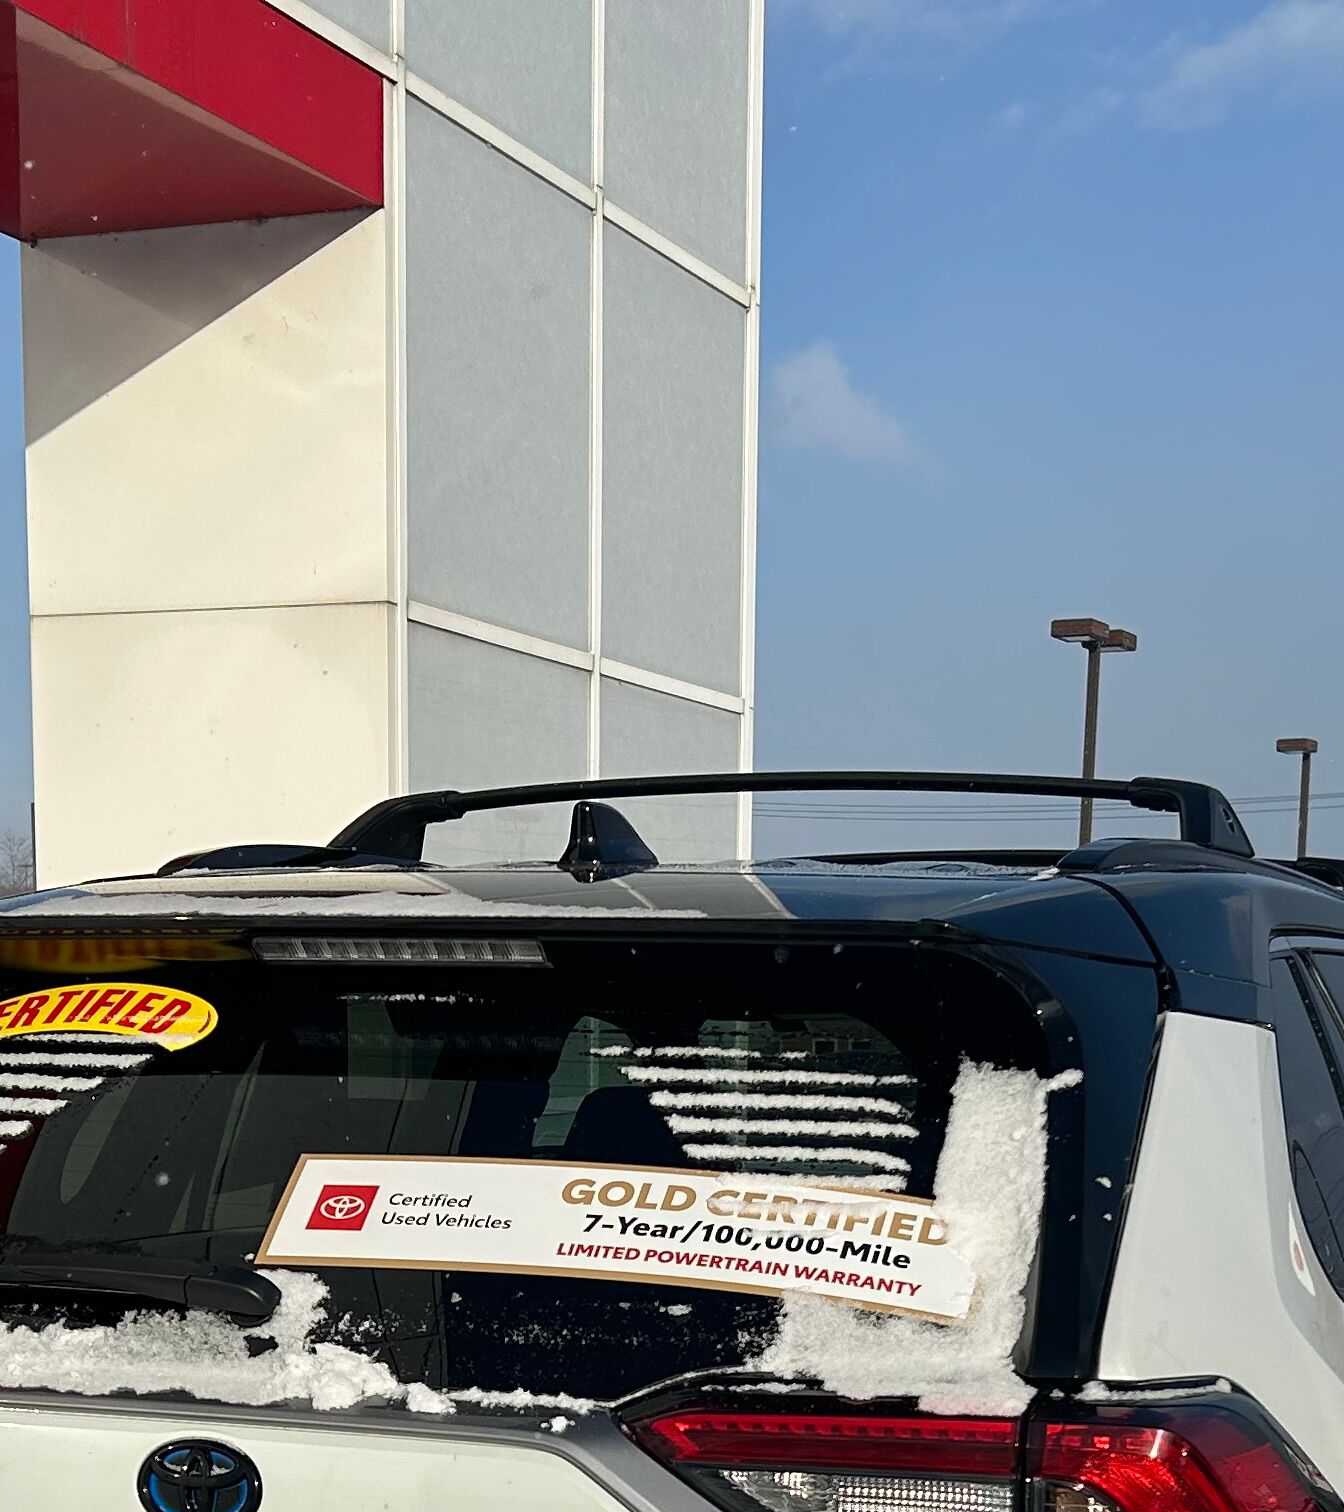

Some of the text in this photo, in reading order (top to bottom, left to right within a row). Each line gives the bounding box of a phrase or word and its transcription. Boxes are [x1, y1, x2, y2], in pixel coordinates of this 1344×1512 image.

[389, 1193, 473, 1208] Certified
[561, 1178, 697, 1213] GOLD
[381, 1211, 513, 1229] Used Vehicles
[583, 1213, 911, 1269] 7-Year/100,000-Mile
[556, 1242, 923, 1297] LIMITED POWERTRAIN WARRANTY
